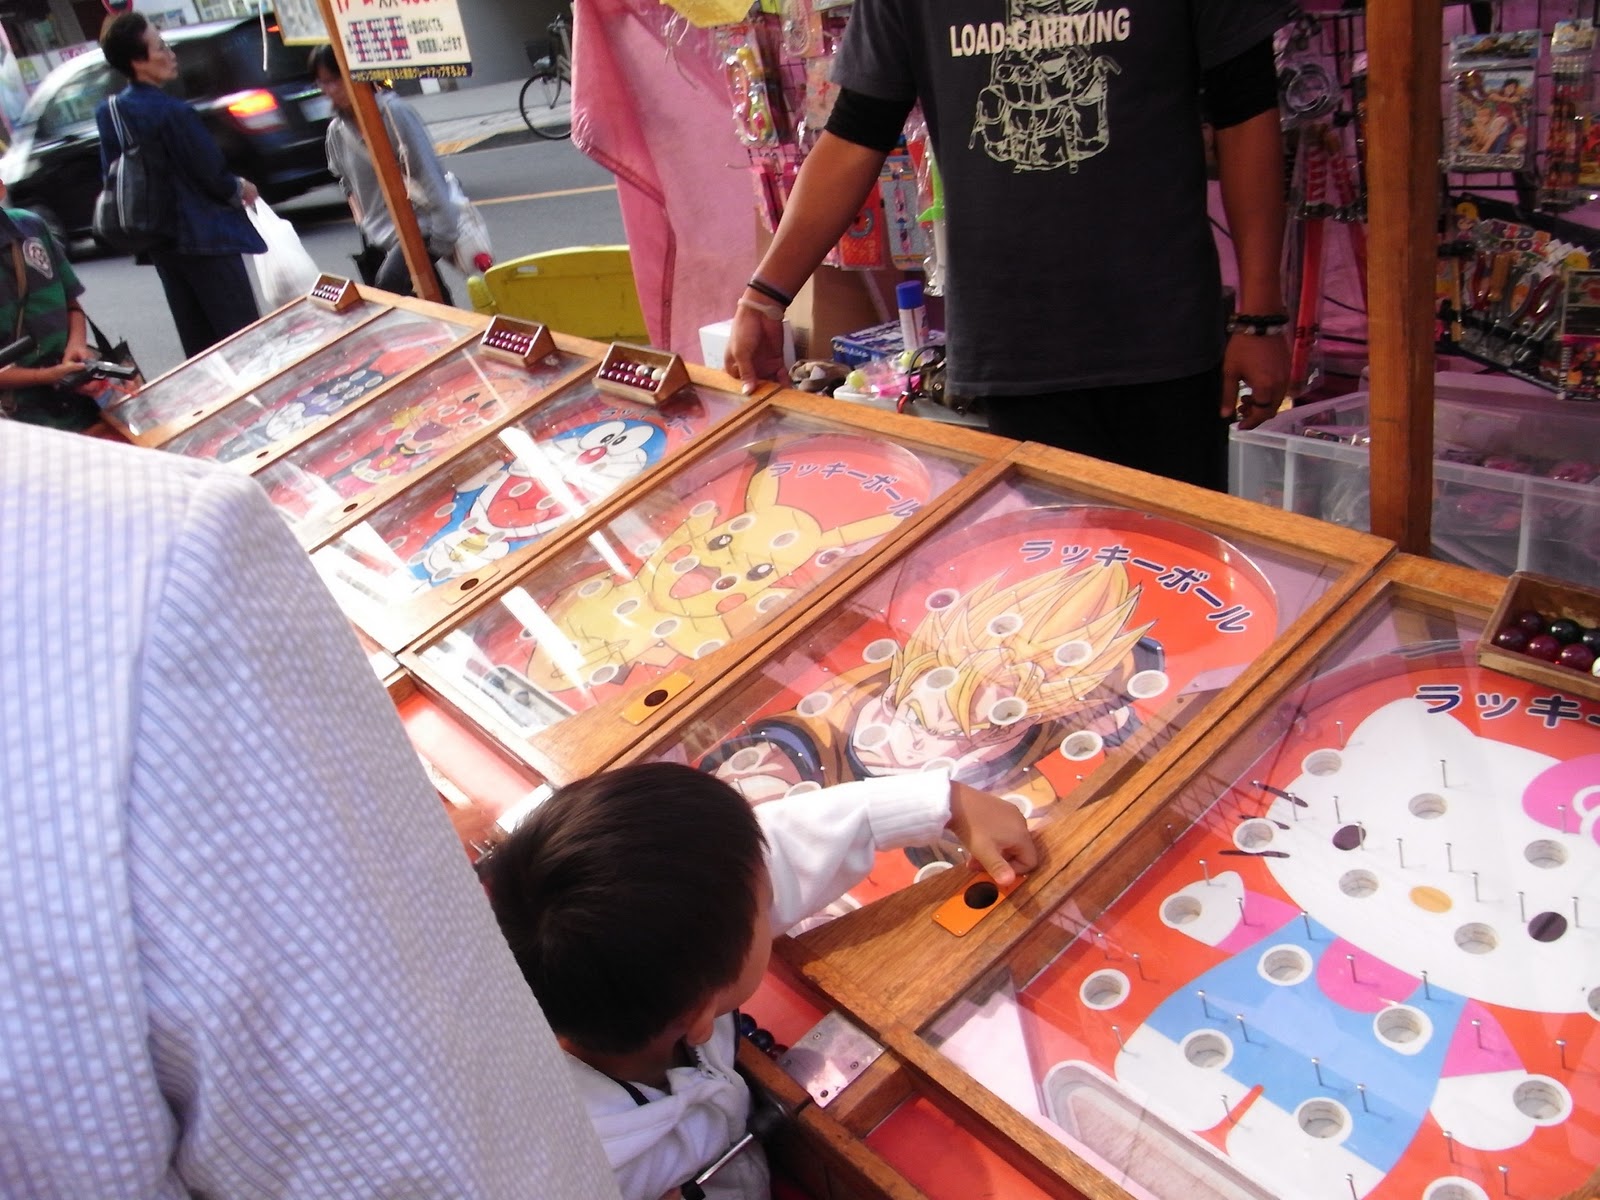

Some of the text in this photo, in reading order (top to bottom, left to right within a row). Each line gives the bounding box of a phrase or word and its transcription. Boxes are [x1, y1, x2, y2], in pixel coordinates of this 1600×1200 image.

[768, 461, 921, 518] ラッキーボール
[1020, 539, 1251, 631] ラッキーボール
